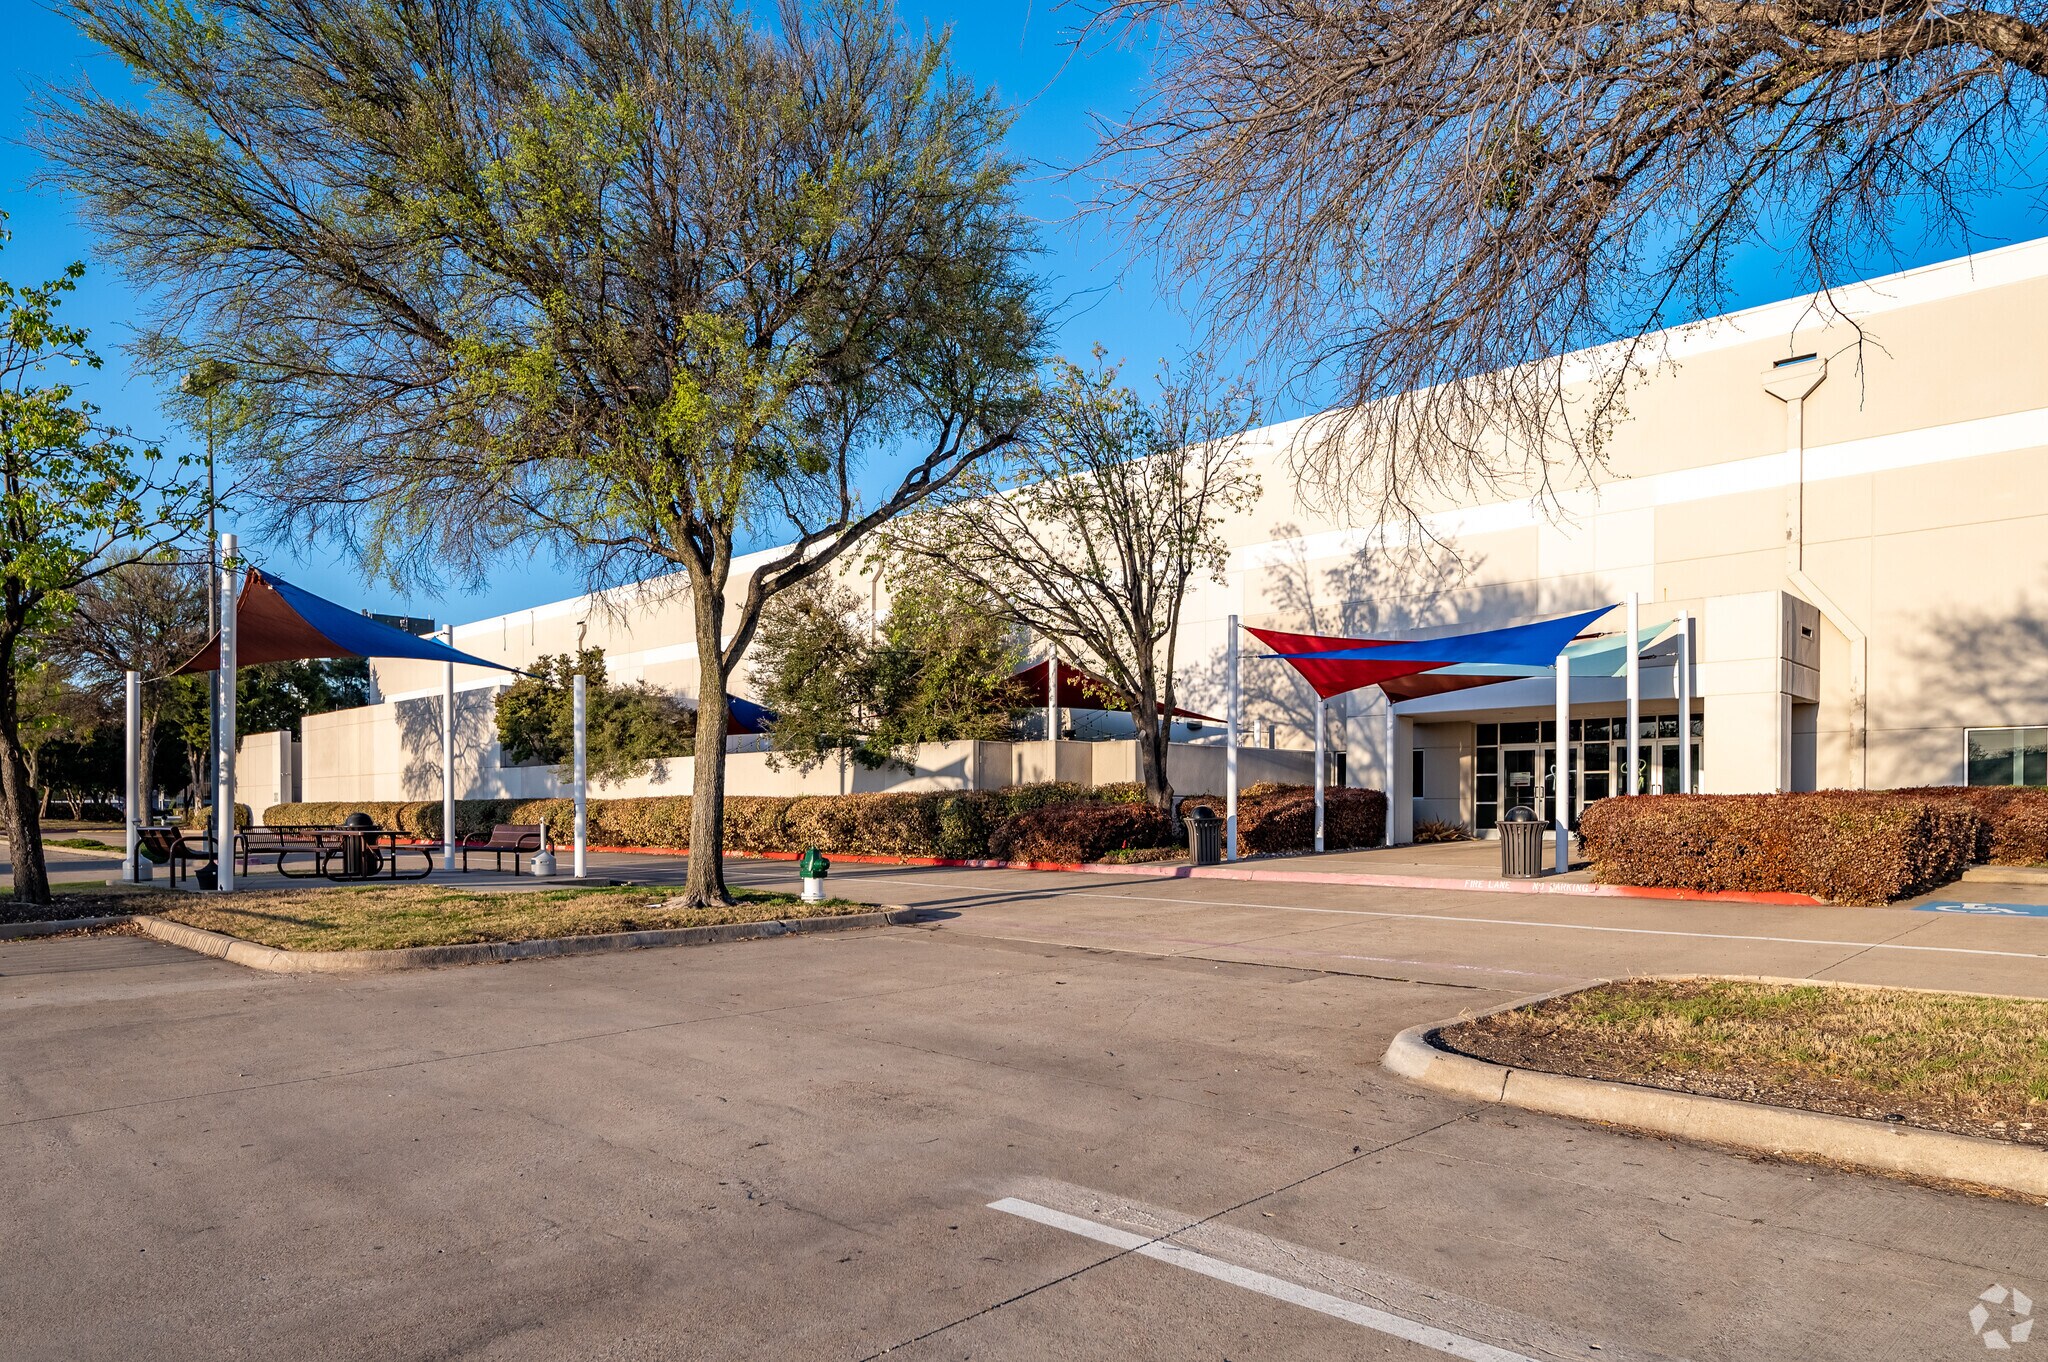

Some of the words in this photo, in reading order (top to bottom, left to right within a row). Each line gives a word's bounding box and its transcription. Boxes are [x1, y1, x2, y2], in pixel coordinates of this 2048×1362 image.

[1464, 879, 1484, 889] FIRE
[1488, 880, 1511, 890] LANE
[1532, 882, 1545, 891] NO
[1549, 882, 1589, 892] PARKING
